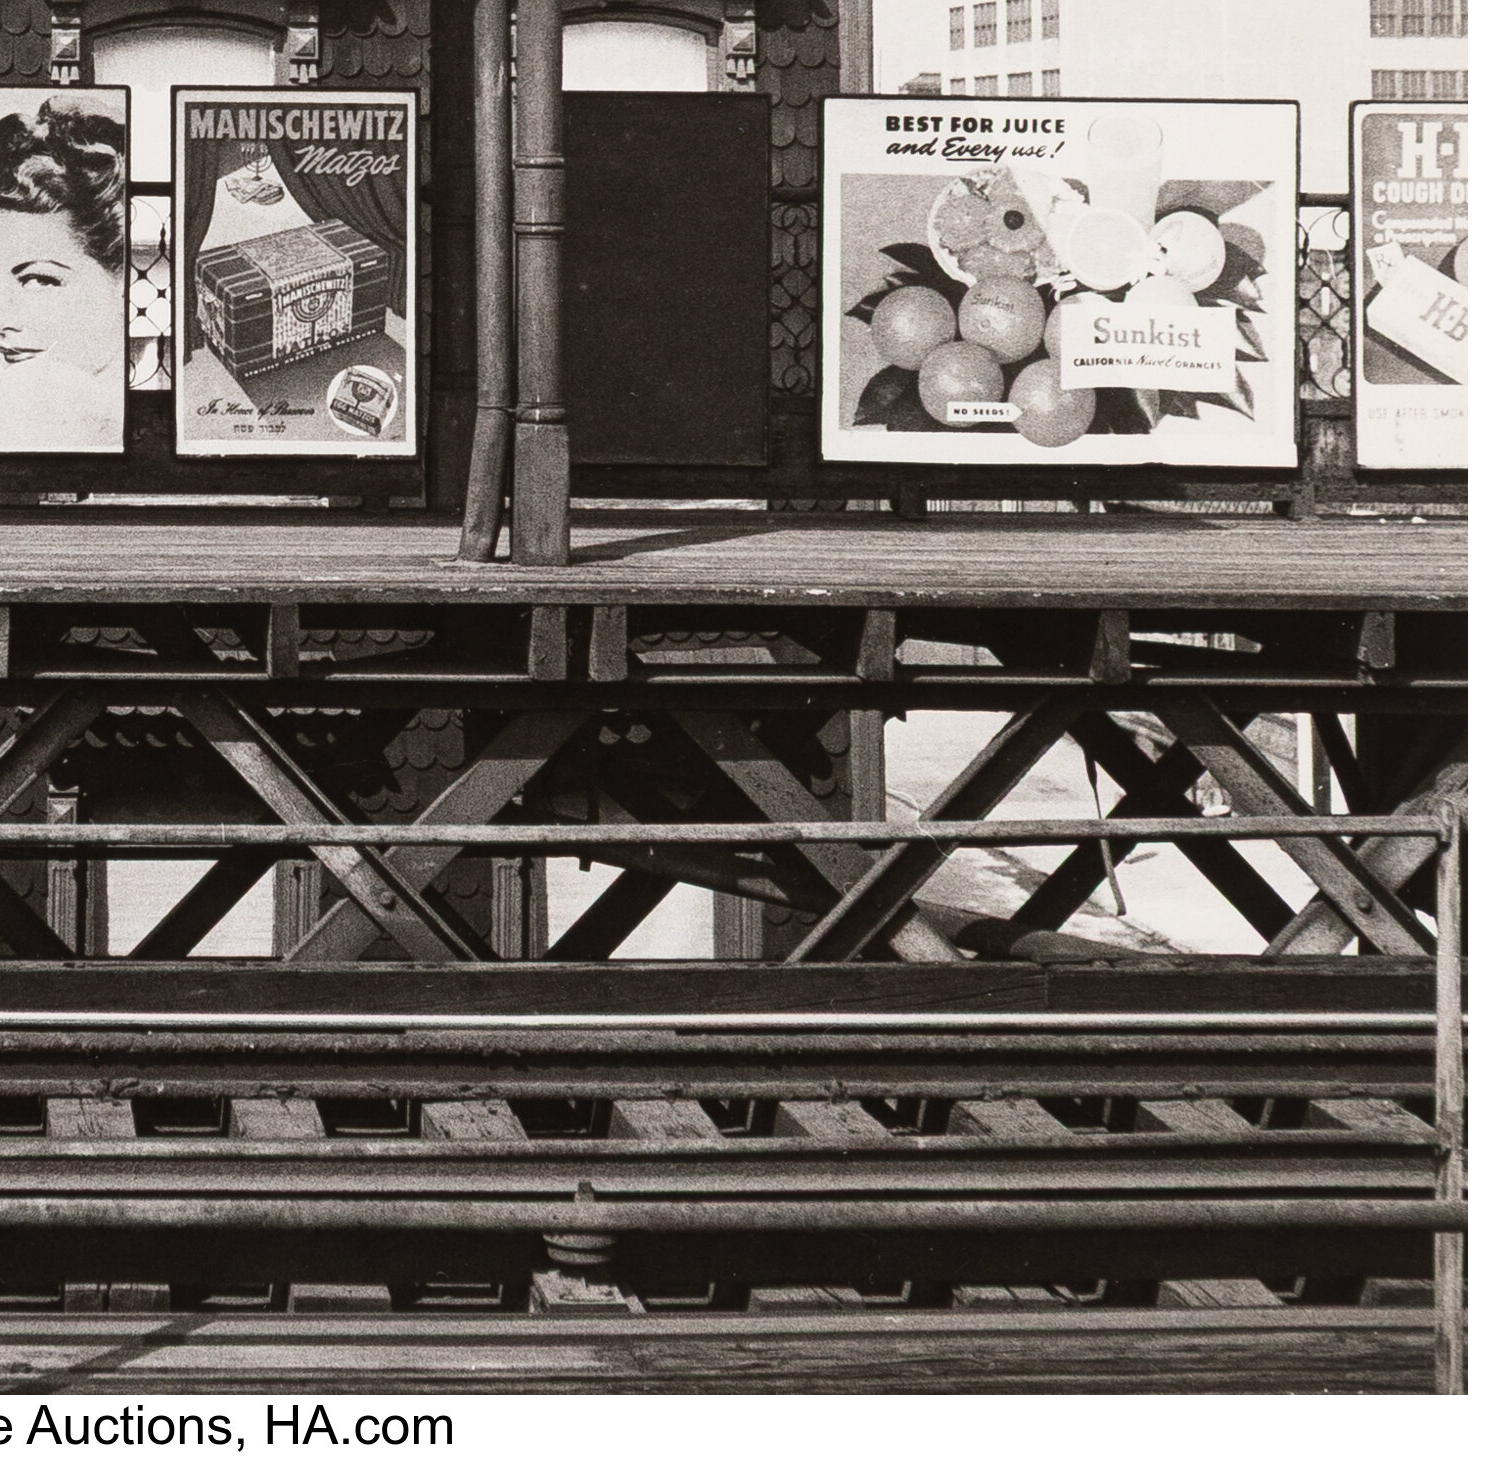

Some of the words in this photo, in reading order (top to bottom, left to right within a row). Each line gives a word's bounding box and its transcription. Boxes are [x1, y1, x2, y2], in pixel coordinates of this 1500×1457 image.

[190, 108, 404, 141] MANISCHEWITZ
[886, 116, 943, 133] BEST
[950, 116, 993, 133] FOR
[1002, 118, 1065, 134] JUICE
[886, 137, 937, 156] and
[941, 137, 1005, 163] Every
[1012, 141, 1064, 159] use!
[294, 145, 400, 186] Matzos
[1373, 181, 1443, 203] COUGH
[1094, 317, 1201, 348] Sunkist
[1073, 357, 1132, 367] CALIFORNIA
[1176, 360, 1222, 369] ORANGES
